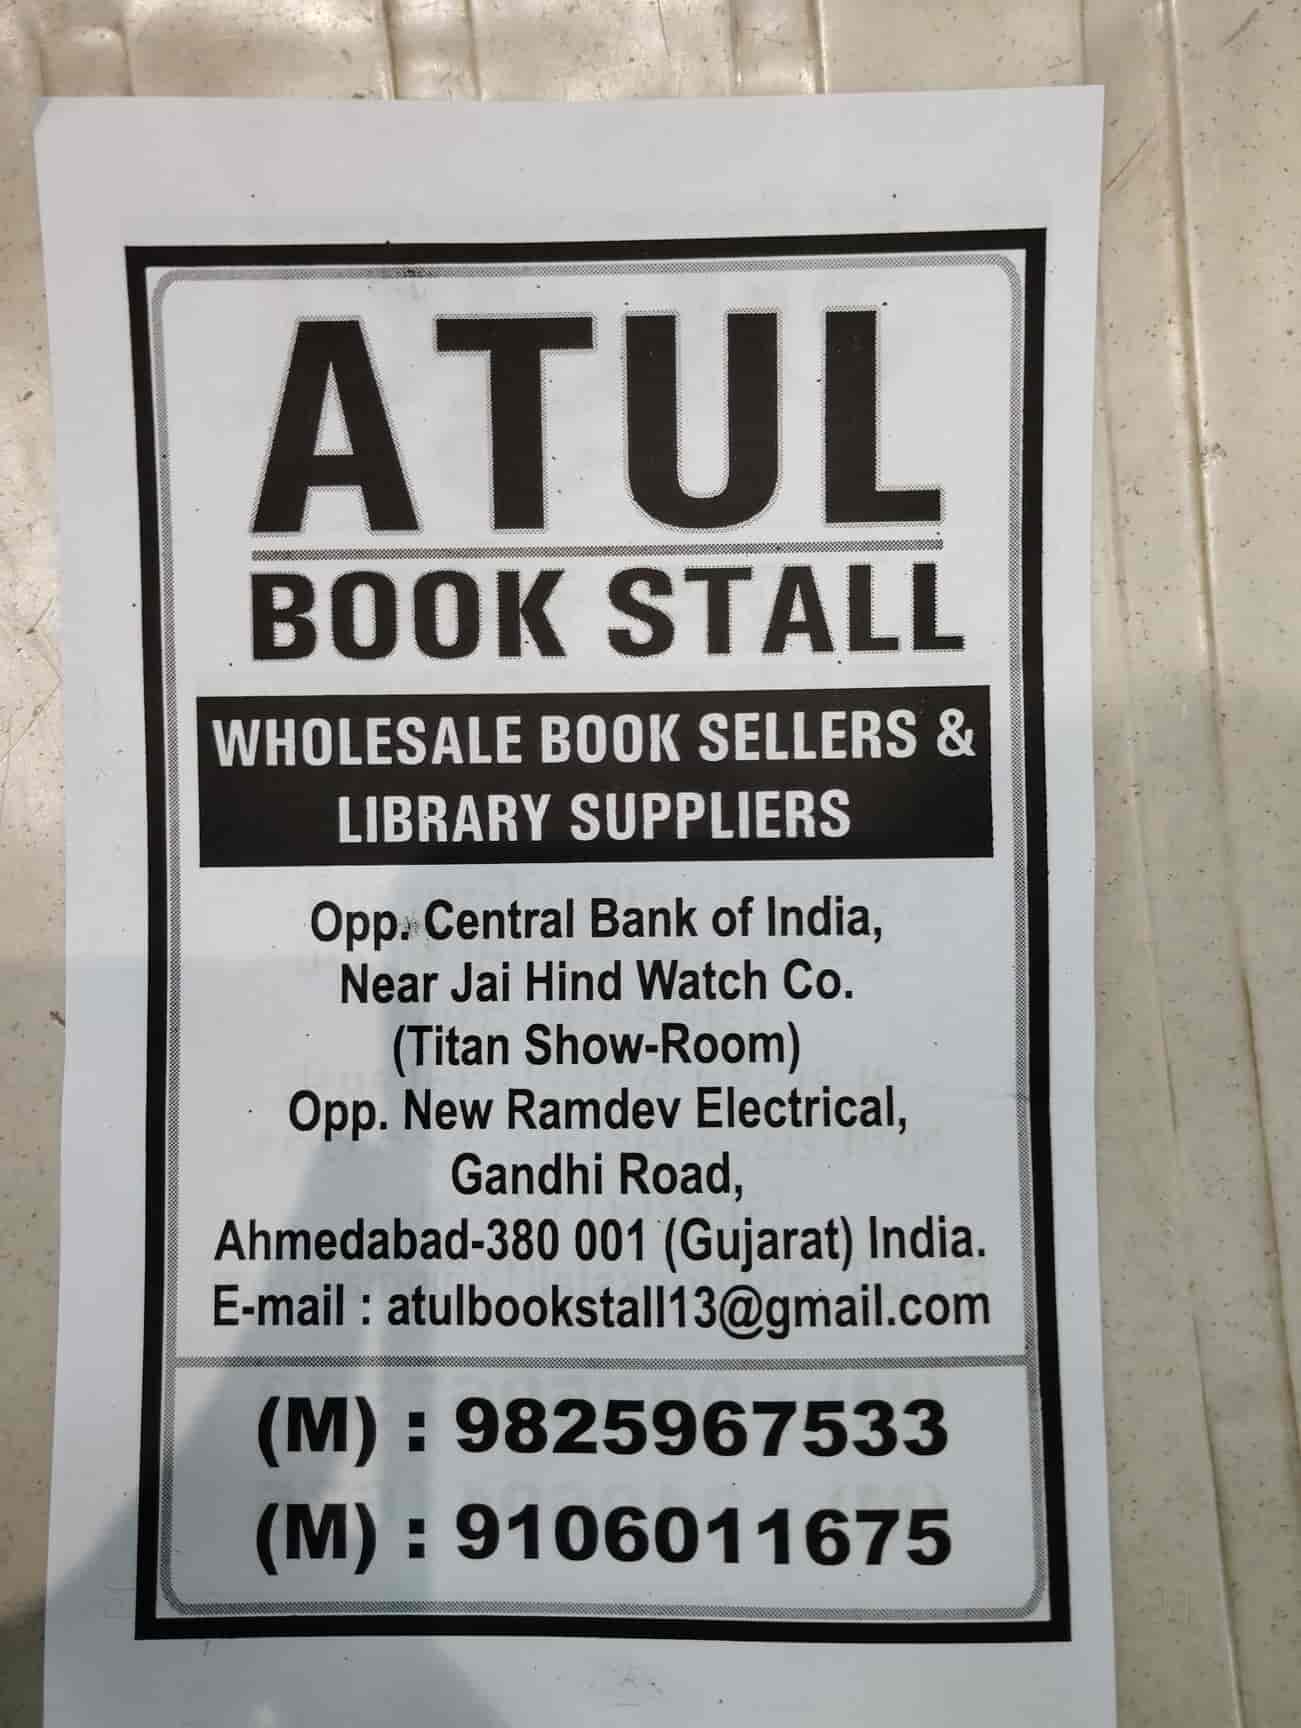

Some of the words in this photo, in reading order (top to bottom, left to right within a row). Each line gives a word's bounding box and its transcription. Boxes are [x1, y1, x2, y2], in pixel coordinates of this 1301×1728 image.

[251, 308, 943, 536] ATUL
[251, 570, 566, 661] BOOK
[607, 563, 965, 658] STALL
[211, 715, 523, 767] WHOLESALE
[540, 713, 681, 764] BOOK
[698, 708, 917, 762] SELLERS
[936, 707, 977, 758] &
[338, 793, 552, 844] LIBRARY
[570, 788, 851, 841] SUPPLIERS
[311, 900, 410, 952] Opp.
[424, 898, 574, 941] Central
[591, 896, 698, 938] Bank
[711, 895, 755, 937] of
[767, 895, 882, 944] India,
[341, 963, 439, 1004] Near
[450, 961, 510, 1003] Jai
[526, 959, 622, 1002] Hind
[636, 958, 767, 1001] Watch
[783, 958, 853, 1000] Co.
[393, 1024, 509, 1078] (Titan
[525, 1021, 800, 1075] Show-Room)
[289, 1089, 388, 1142] Opp.
[404, 1088, 494, 1130] New
[508, 1087, 681, 1130] Ramdev
[697, 1084, 907, 1135] Electrical,
[451, 1151, 603, 1196] Gandhi
[620, 1151, 743, 1203] Road,
[213, 1217, 559, 1261] Ahmedabad-380
[574, 1217, 643, 1262] 001
[665, 1215, 853, 1274] (Gujarat)
[869, 1214, 985, 1259] India.
[213, 1283, 345, 1327] E-mail
[387, 1283, 990, 1340] atulbookstall13@gmail.com
[257, 1395, 377, 1469] (M)
[455, 1396, 948, 1458] 9825967533
[255, 1502, 377, 1577] (M)
[456, 1503, 952, 1566] 9106011675
